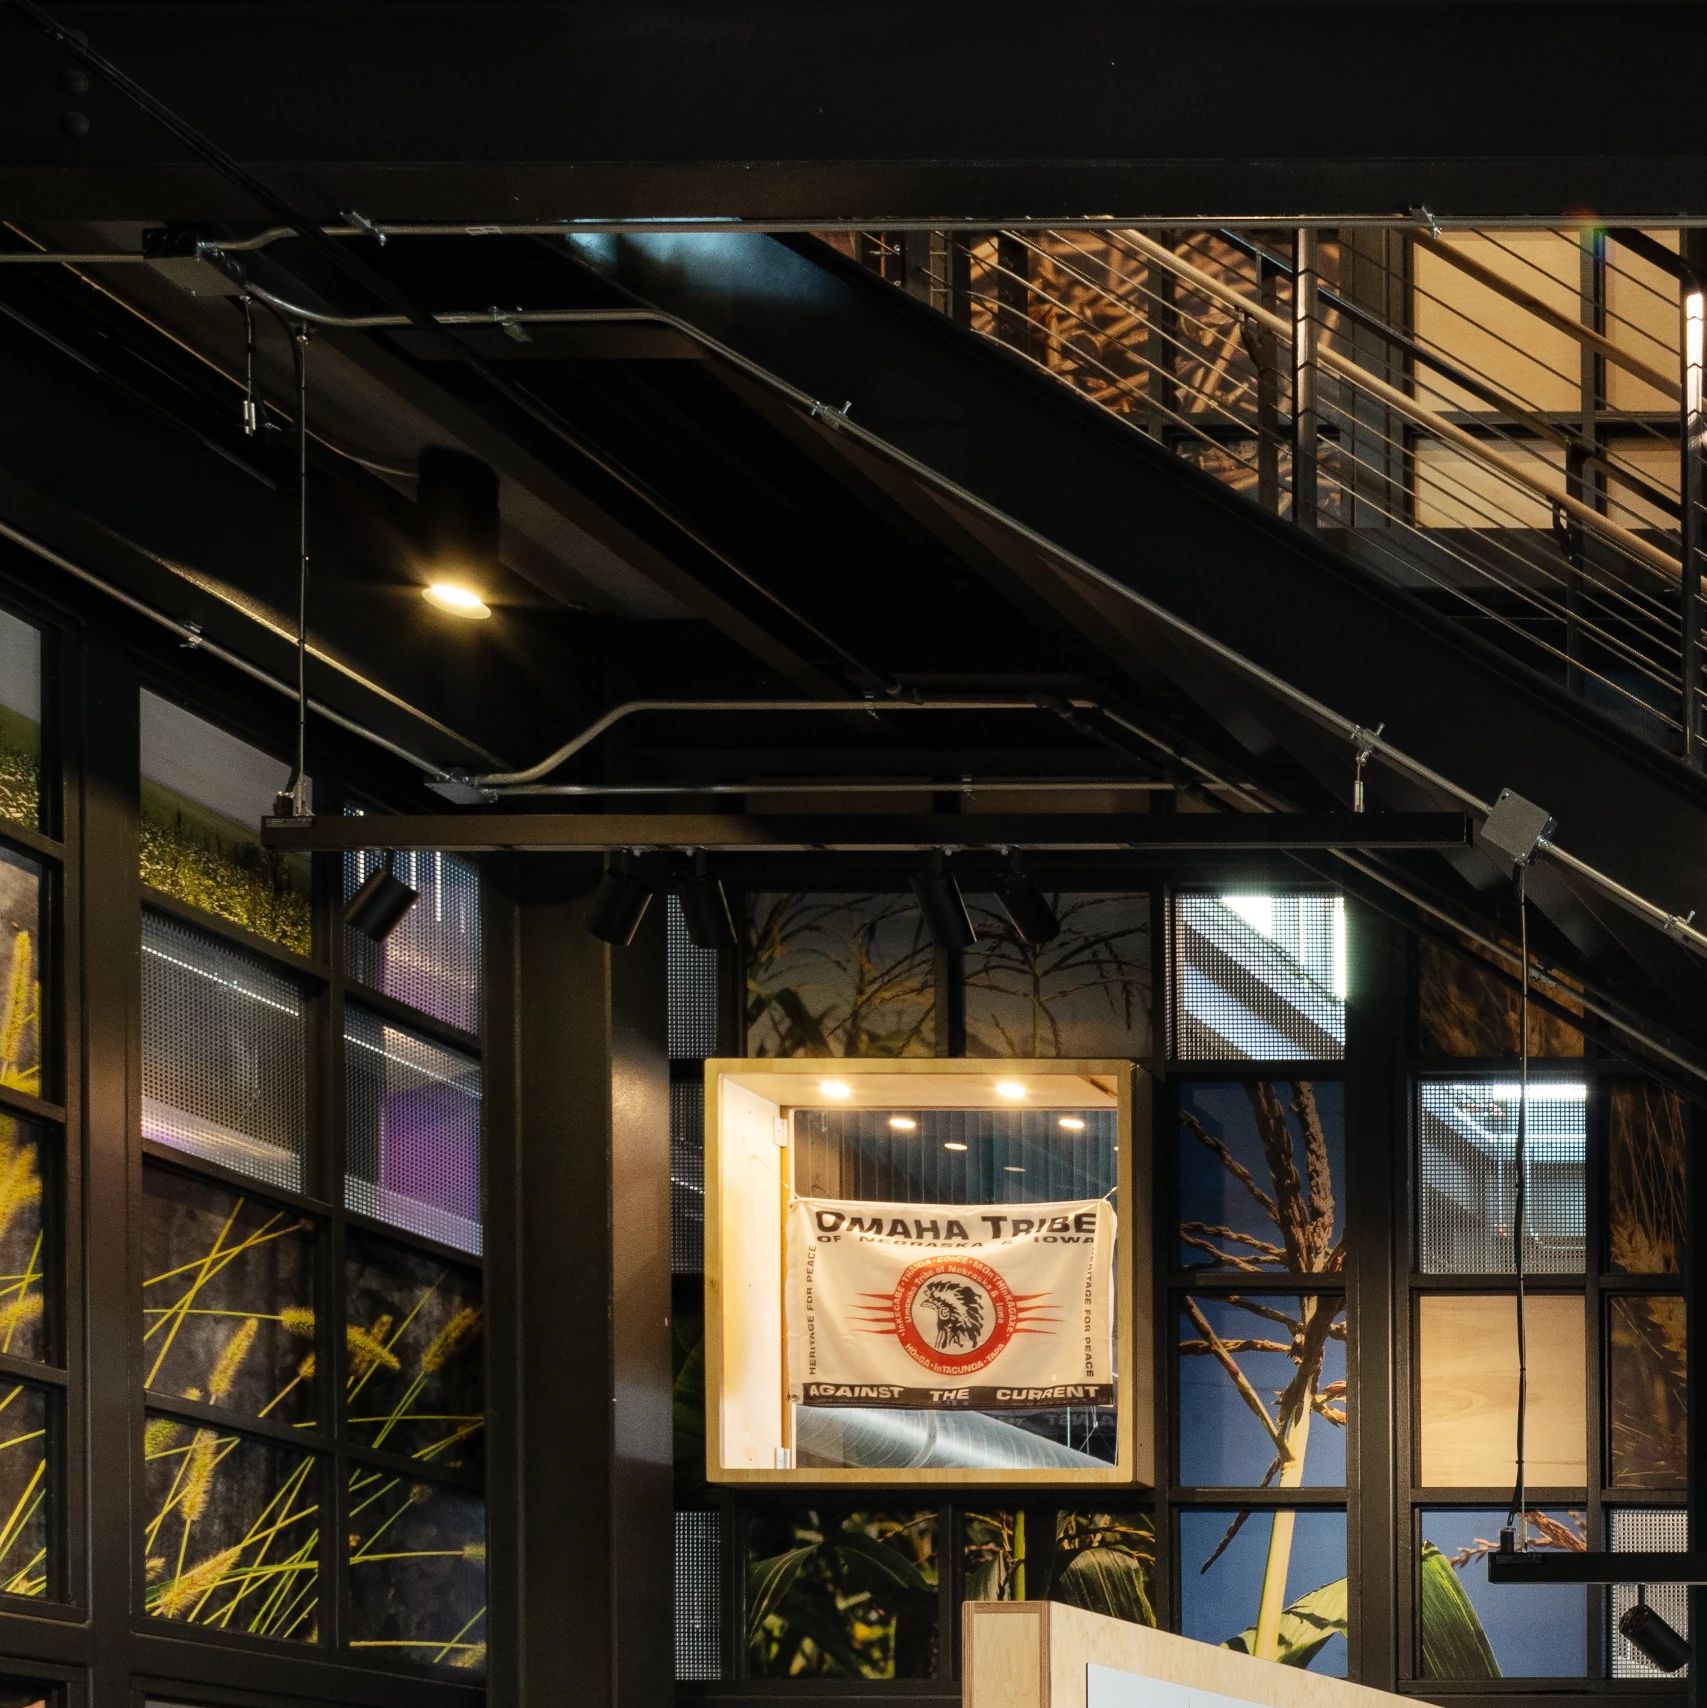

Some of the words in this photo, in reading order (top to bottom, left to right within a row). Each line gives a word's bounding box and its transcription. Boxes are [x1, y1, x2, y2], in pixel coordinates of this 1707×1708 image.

[815, 1211, 969, 1240] OMAHA
[981, 1213, 1096, 1240] TRIBE
[806, 1245, 817, 1283] PEACE
[806, 1287, 815, 1311] FOR
[1084, 1309, 1092, 1332] FOR
[808, 1315, 817, 1375] HERITAGE
[1084, 1337, 1095, 1377] PEACE
[809, 1384, 904, 1399] AGAINST
[929, 1388, 970, 1402] THE
[996, 1386, 1099, 1401] CURRENT
